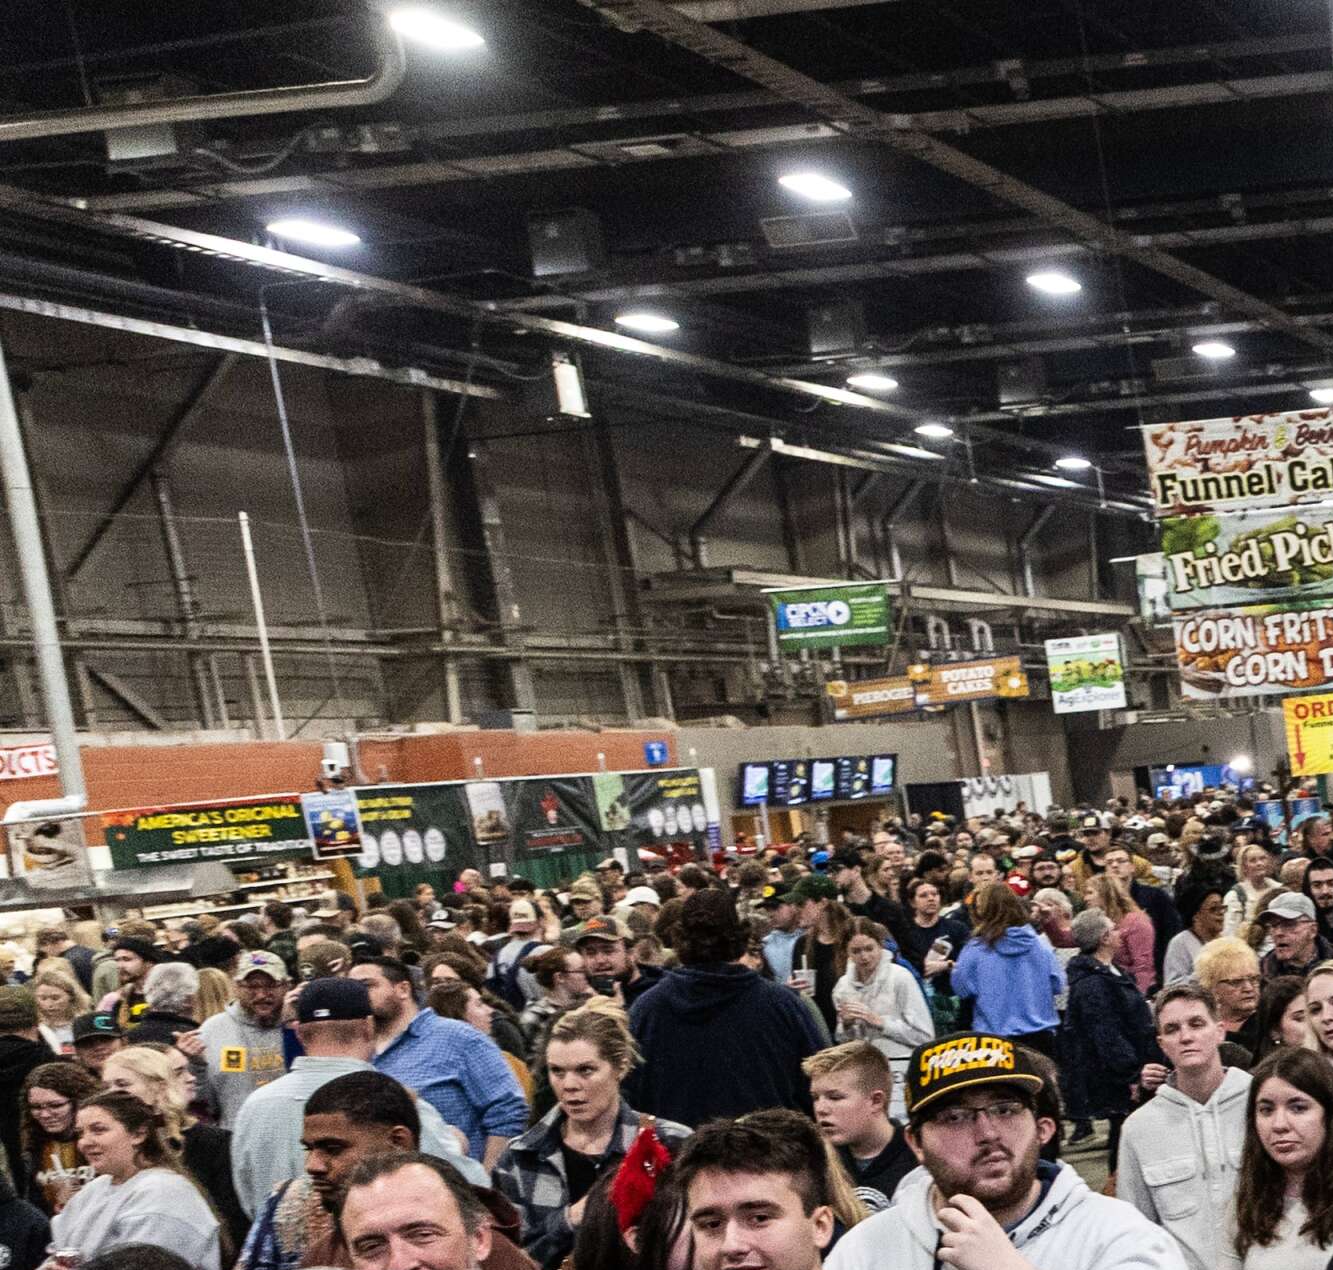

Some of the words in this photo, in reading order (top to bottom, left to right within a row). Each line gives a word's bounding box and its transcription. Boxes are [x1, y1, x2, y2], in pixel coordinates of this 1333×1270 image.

[1185, 429, 1269, 456] Pumpkin
[1157, 465, 1275, 504] Funnel
[1168, 540, 1268, 592] Fried
[1183, 617, 1256, 653] CORN
[1226, 651, 1308, 686] CORN
[137, 811, 224, 831] AMERICA'S
[225, 805, 300, 822] ORIGINAL
[172, 824, 272, 844] SWEETENER
[920, 1037, 1015, 1087] STEELERS
